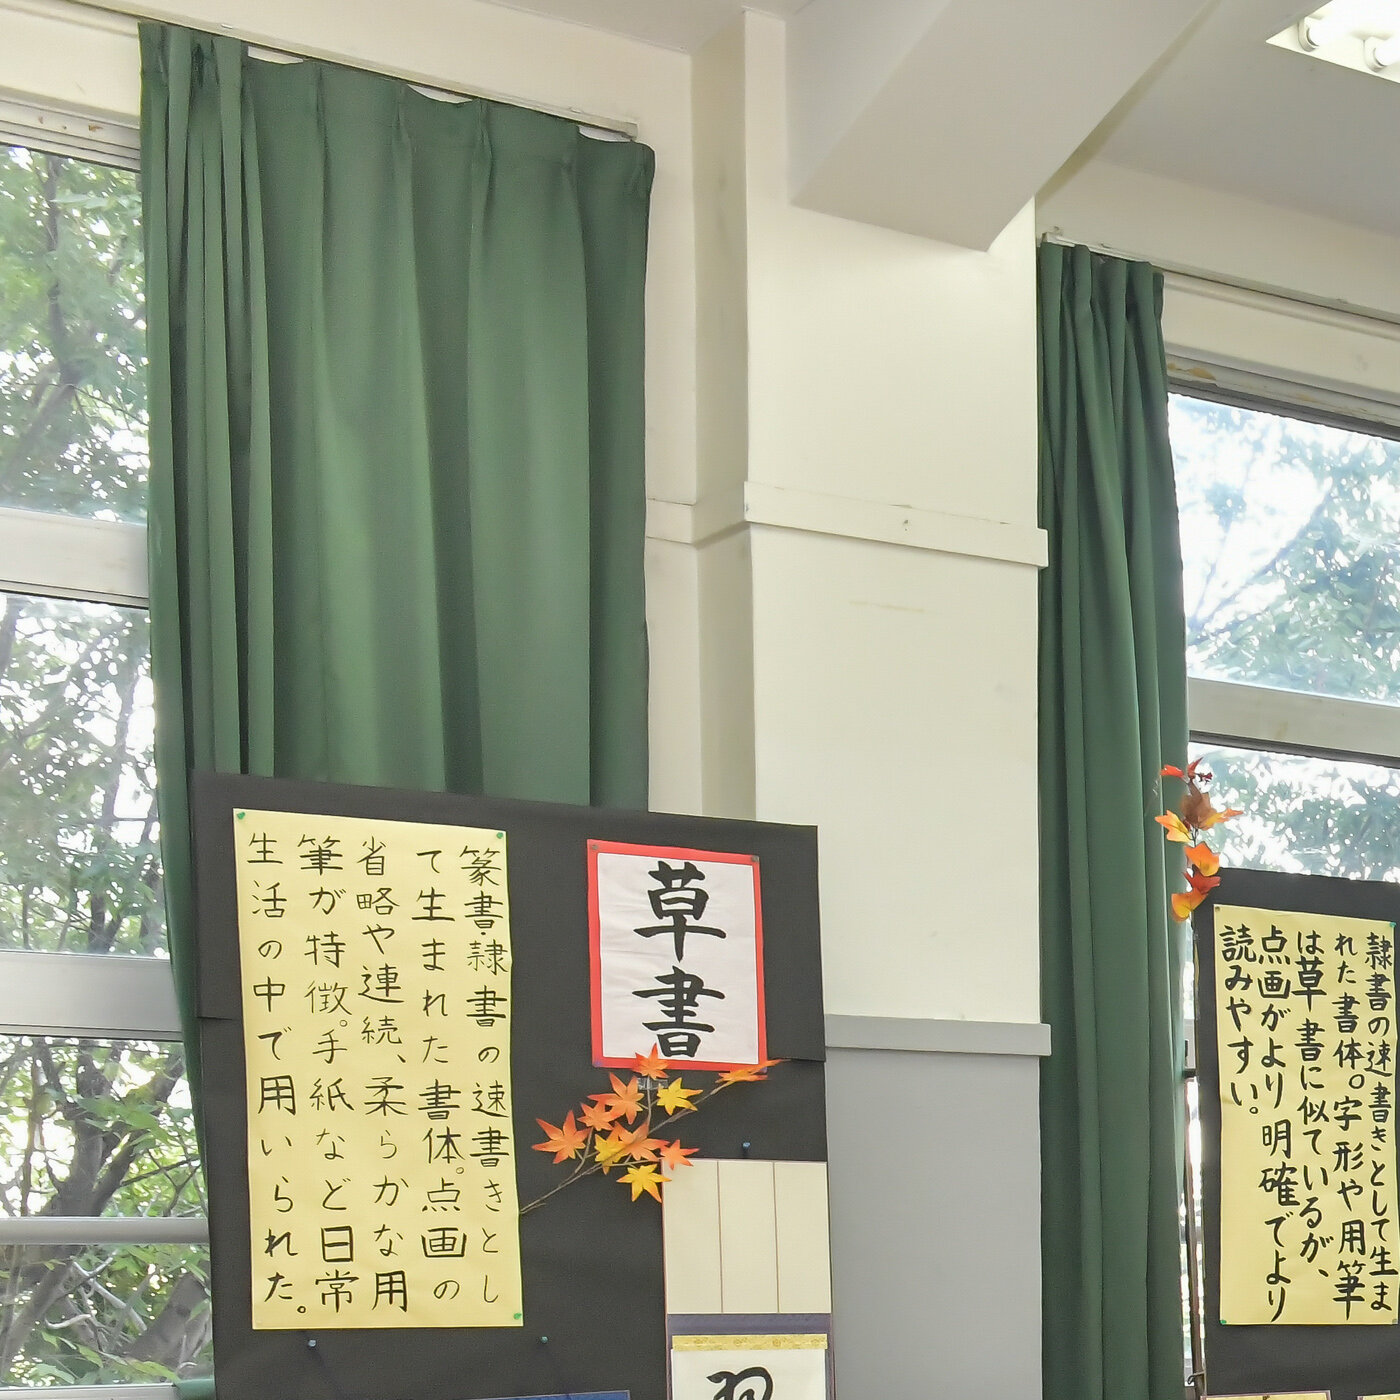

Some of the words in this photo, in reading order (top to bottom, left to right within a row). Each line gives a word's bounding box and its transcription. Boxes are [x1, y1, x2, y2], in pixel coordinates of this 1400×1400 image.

[246, 832, 307, 1314] 生活の中で用いられた。
[297, 834, 360, 1313] 筆が特徴。手紙など日常
[356, 836, 410, 1313] 省略や連続、柔らかな用
[411, 850, 467, 1301] て生まれた書体。点画の
[459, 846, 510, 1303] 篆書・隷書の速書きとし
[633, 861, 727, 1058] 草書
[1218, 925, 1259, 1116] 読みやすい。
[1257, 924, 1301, 1323] 点画がより明確でより
[1291, 930, 1334, 1278] は草書に似ているが、
[1331, 932, 1367, 1321] れた書体。字形や用筆
[1364, 931, 1399, 1312] 隷書の速書きとして生ま
